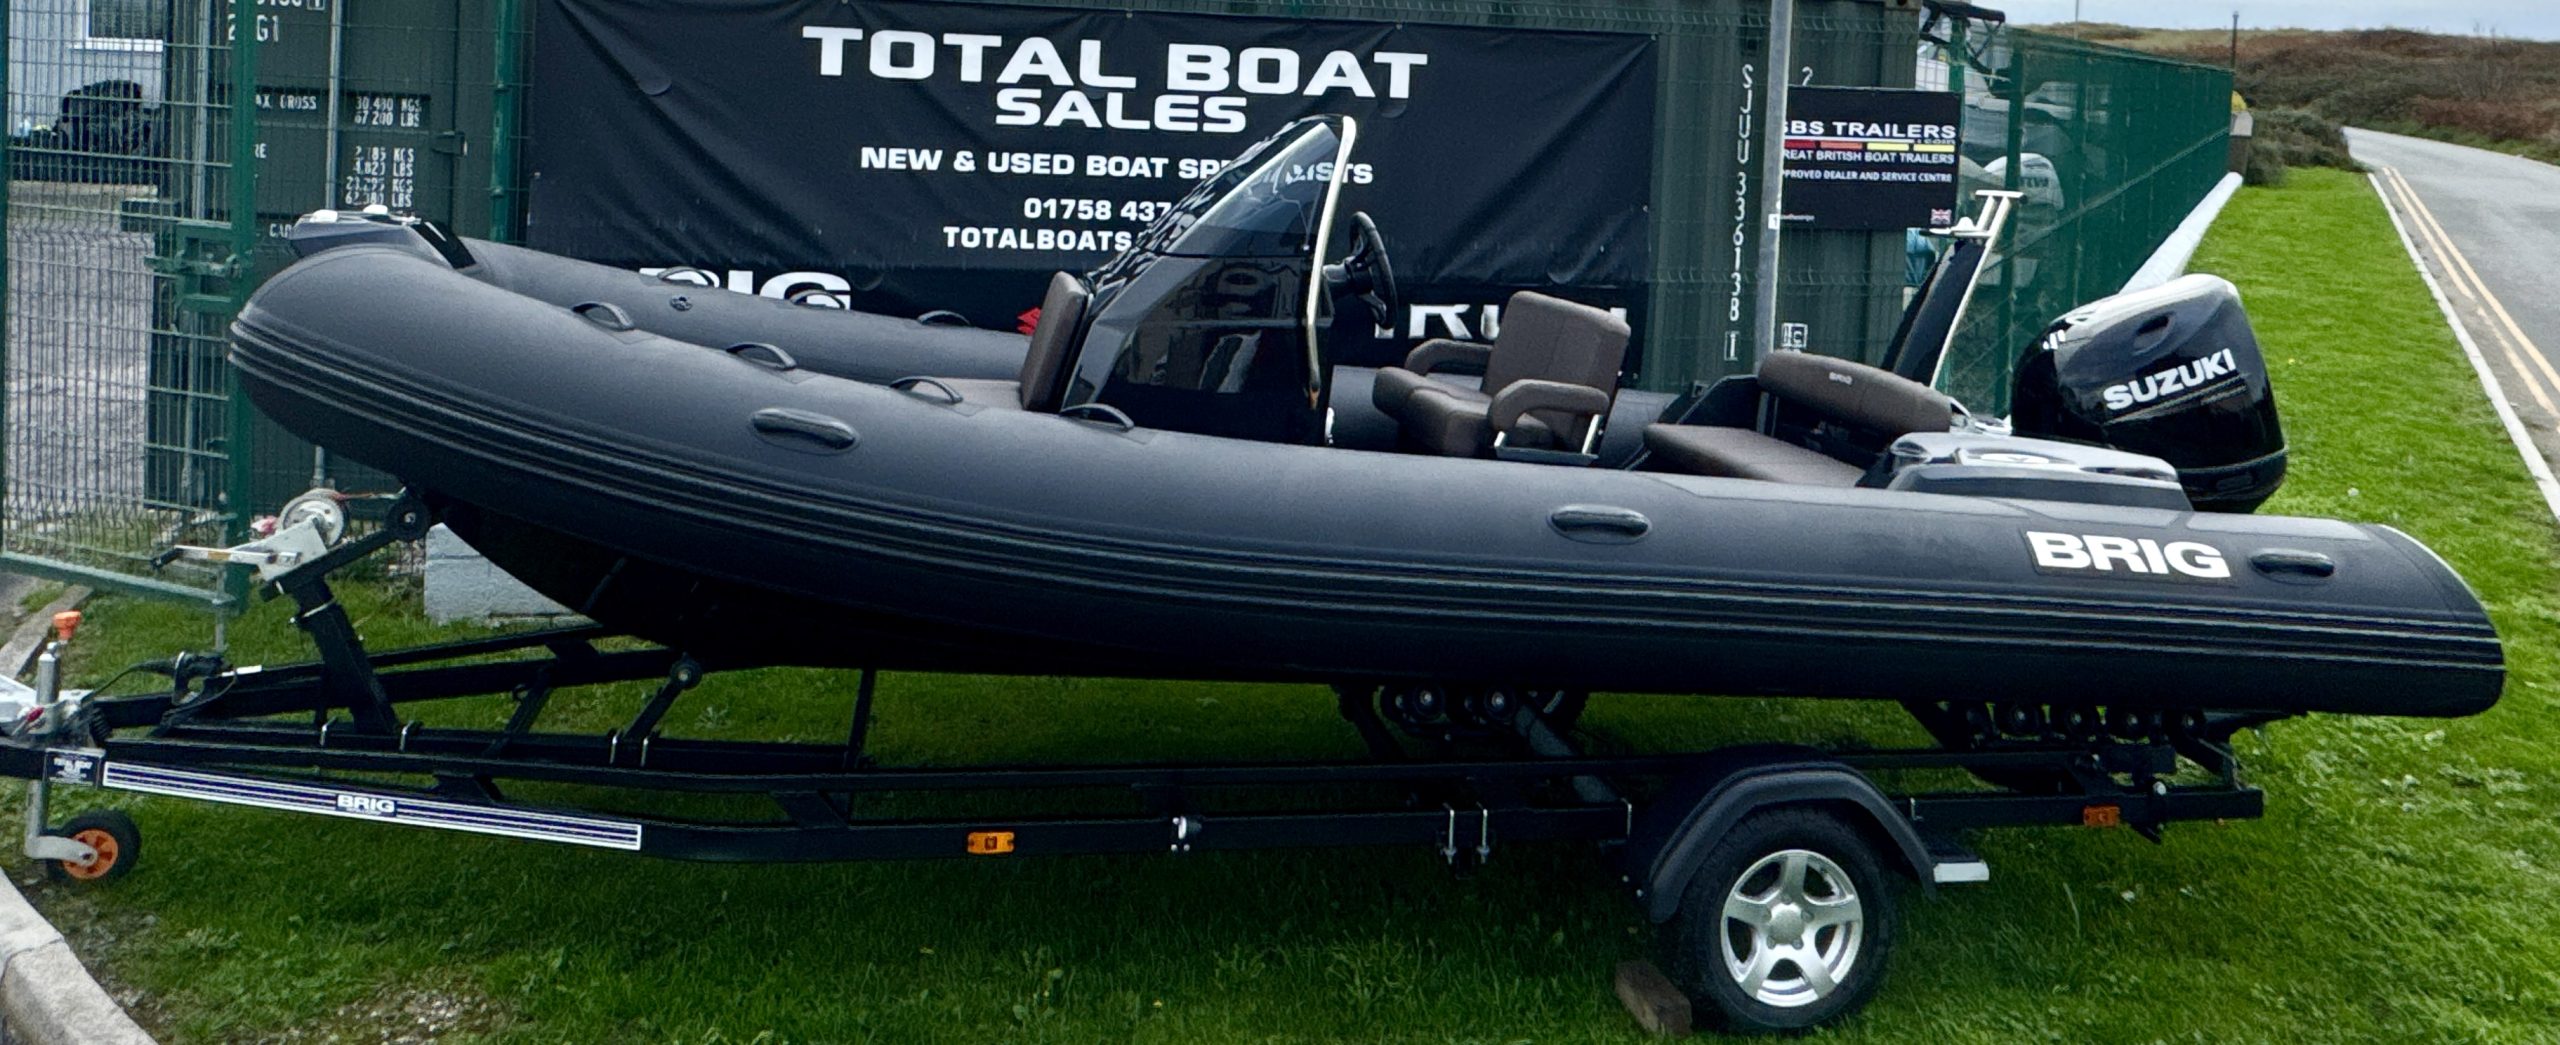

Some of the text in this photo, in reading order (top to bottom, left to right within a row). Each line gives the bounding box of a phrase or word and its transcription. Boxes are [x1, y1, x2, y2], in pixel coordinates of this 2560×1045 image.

[803, 26, 1428, 99] TOTAL BOAT
[995, 88, 1247, 133] SALES
[1833, 122, 1956, 139] TRAILERS
[861, 147, 943, 171] NEW
[954, 151, 976, 172] &
[988, 152, 1075, 175] USED
[1086, 155, 1169, 178] BOAT
[1816, 150, 1862, 163] BRITISH
[1864, 151, 1896, 163] BOAT
[1900, 153, 1955, 165] TRAILERS
[1823, 170, 1858, 180] DEALER
[1859, 170, 1880, 181] AND
[1881, 171, 1917, 182] SERVICE
[1918, 172, 1953, 183] CENTRE
[1024, 197, 1112, 220] 01758
[2103, 348, 2237, 411] SUZUKI
[2026, 531, 2231, 578] BRIG
[337, 794, 395, 813] BRIG
